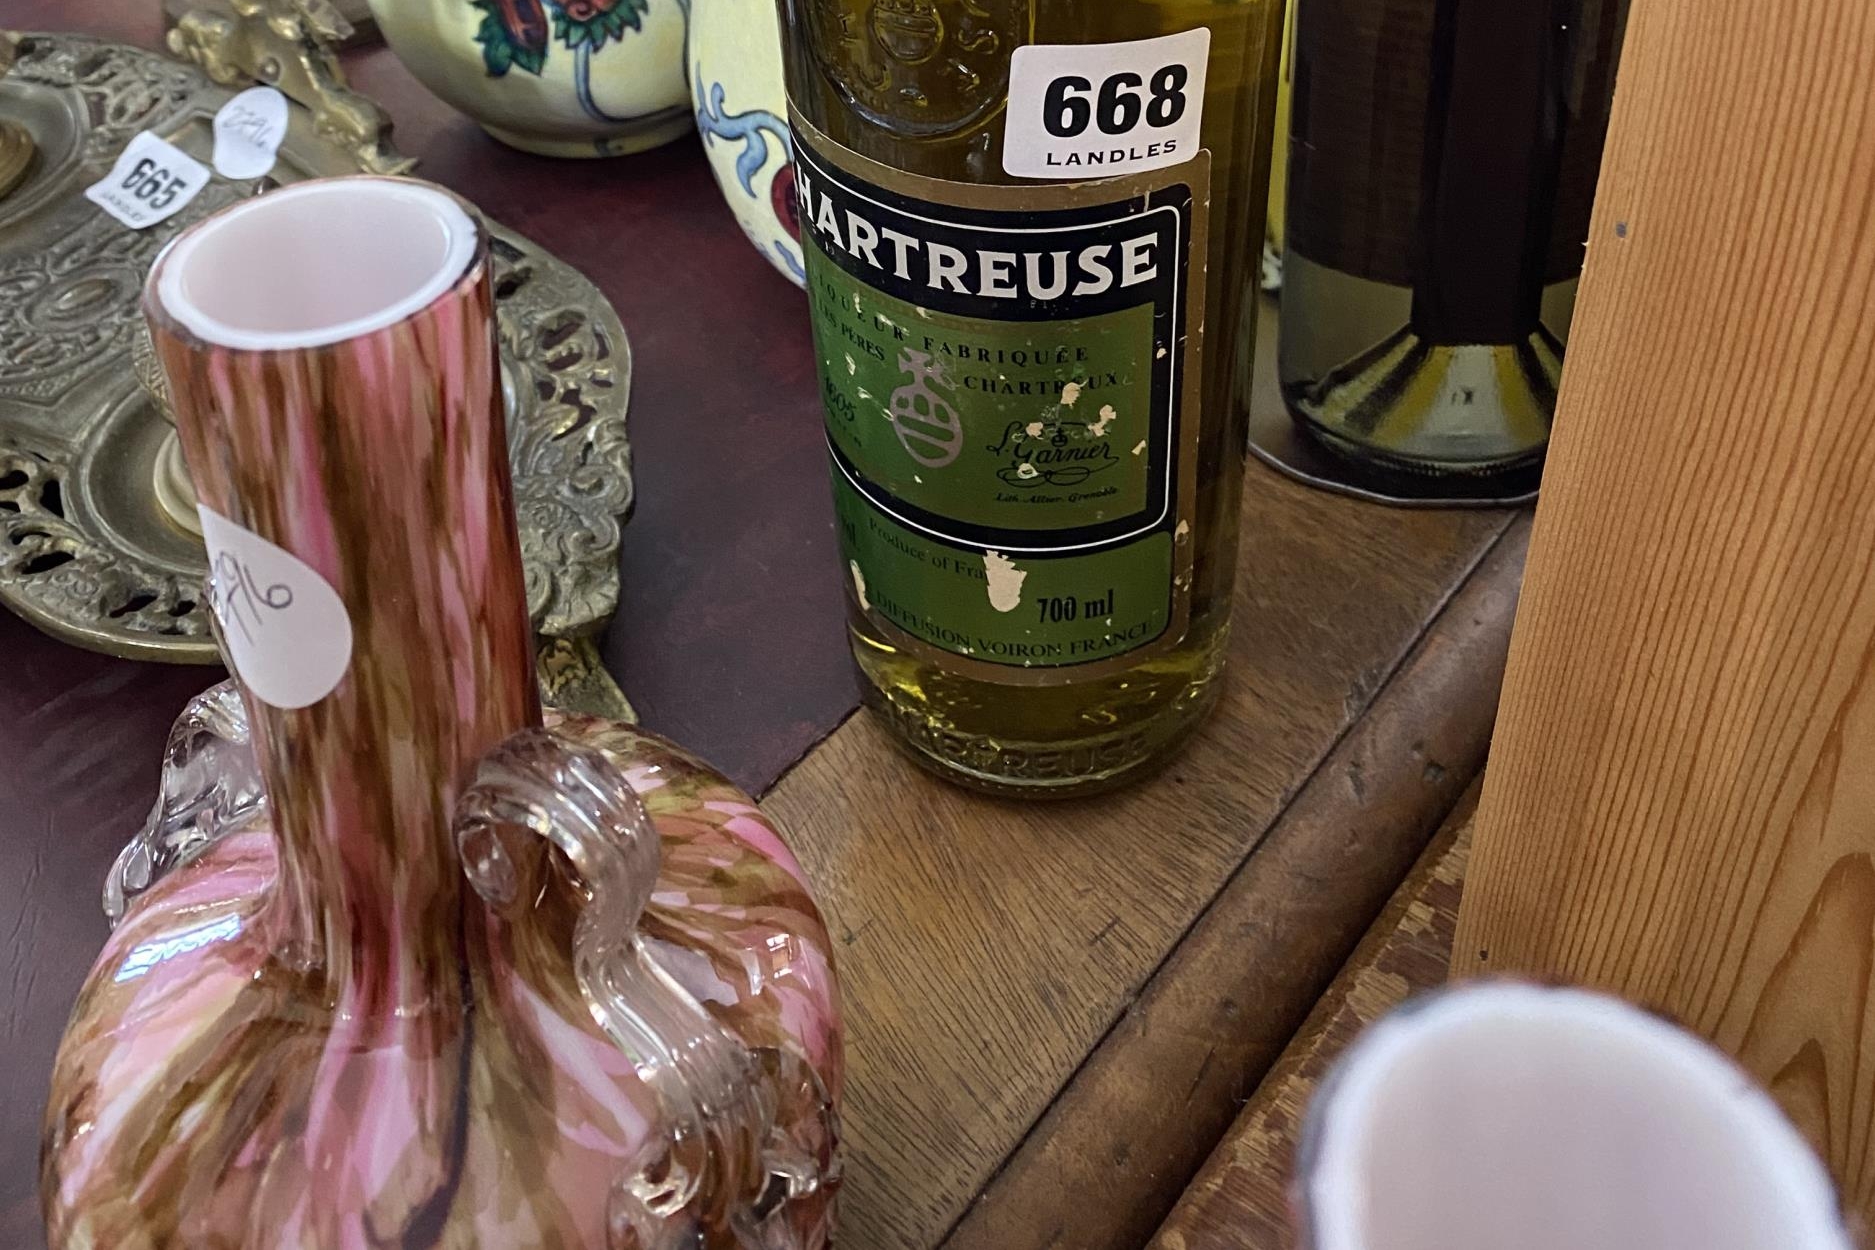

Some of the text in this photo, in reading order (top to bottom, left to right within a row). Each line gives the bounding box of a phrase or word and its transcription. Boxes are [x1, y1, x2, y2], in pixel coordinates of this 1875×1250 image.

[1042, 63, 1189, 140] 668
[1045, 139, 1178, 168] LANDLES
[121, 157, 188, 211] 665
[795, 159, 1159, 300] HARTREUSE
[962, 371, 1119, 398] CHARTRUX
[931, 556, 949, 571] of
[1036, 588, 1115, 624] 700 ml
[976, 639, 1063, 658] VOIRON
[1068, 620, 1152, 656] FRANCE
